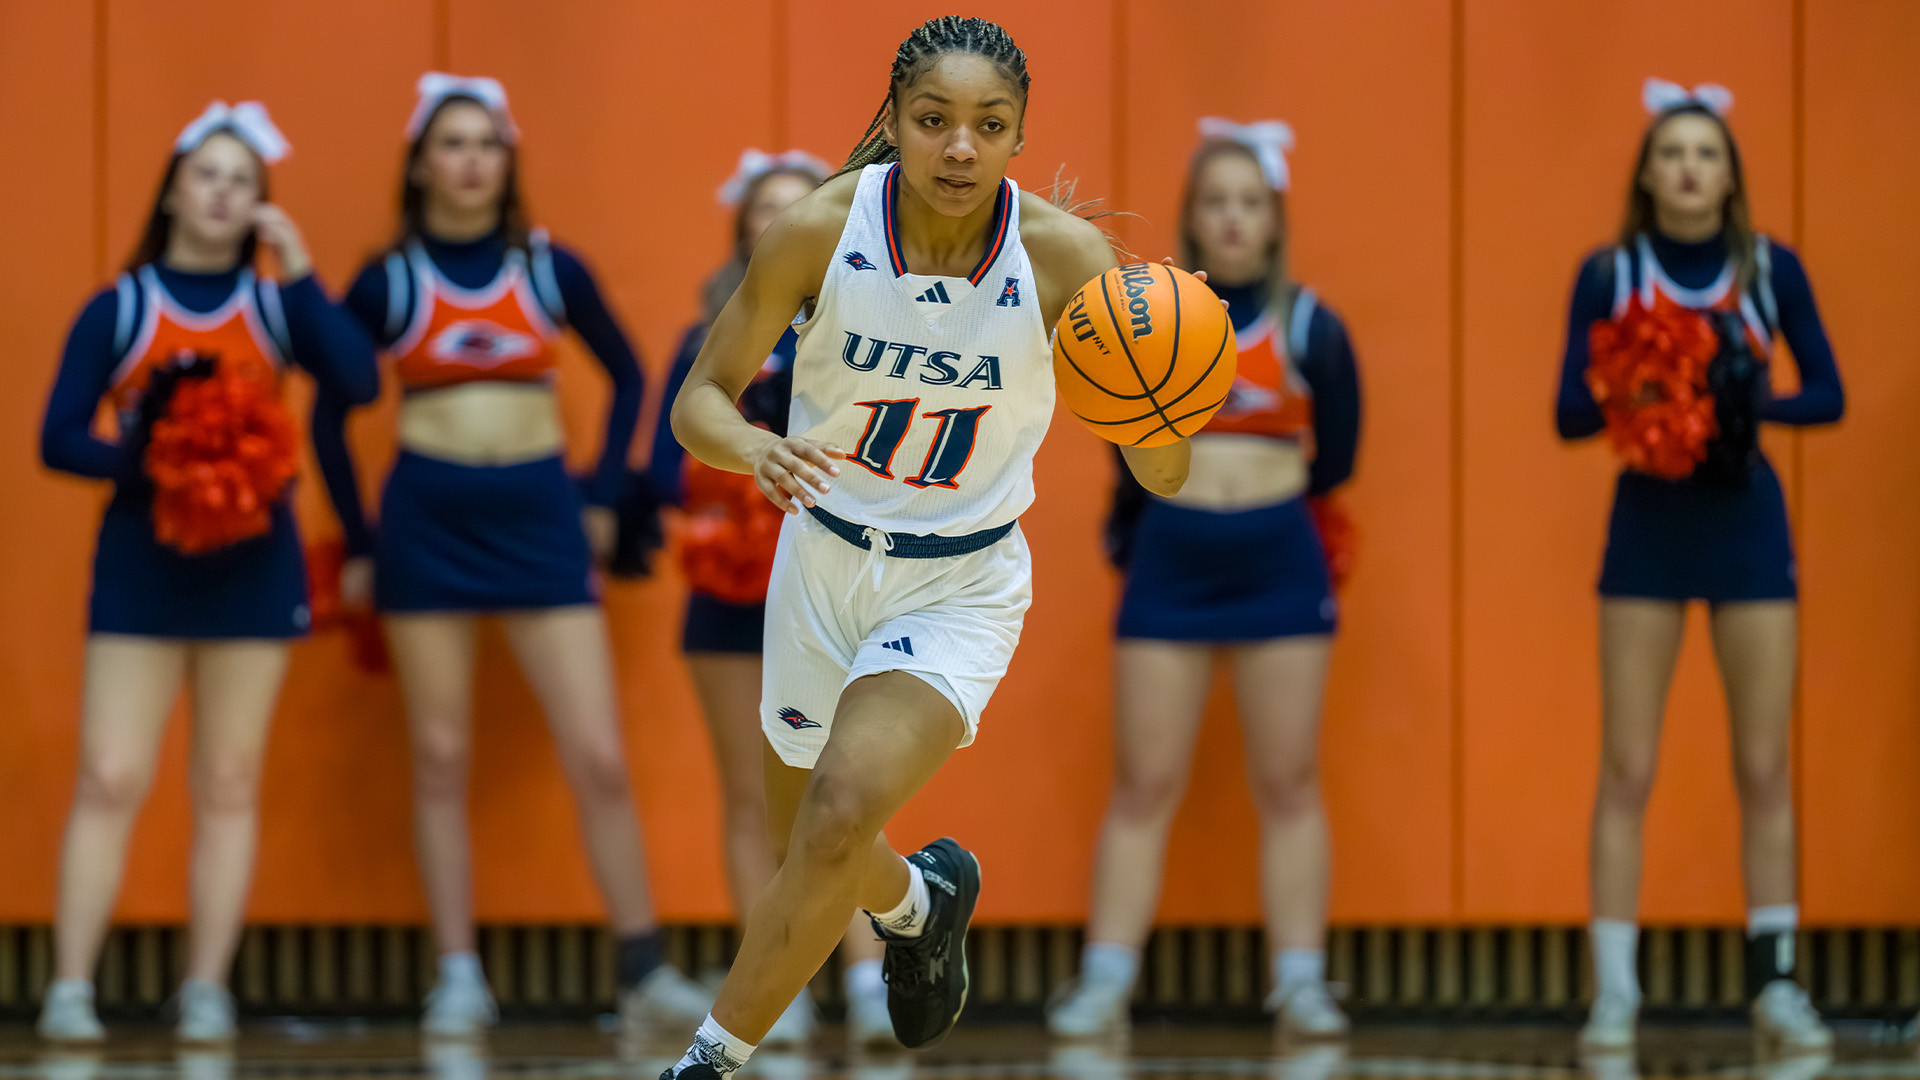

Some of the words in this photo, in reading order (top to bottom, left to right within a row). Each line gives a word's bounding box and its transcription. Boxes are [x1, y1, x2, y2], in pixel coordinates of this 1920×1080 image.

[1068, 290, 1097, 342] EVO
[1092, 336, 1111, 355] NXT
[841, 330, 1004, 391] UTSA
[845, 396, 993, 491] 11
